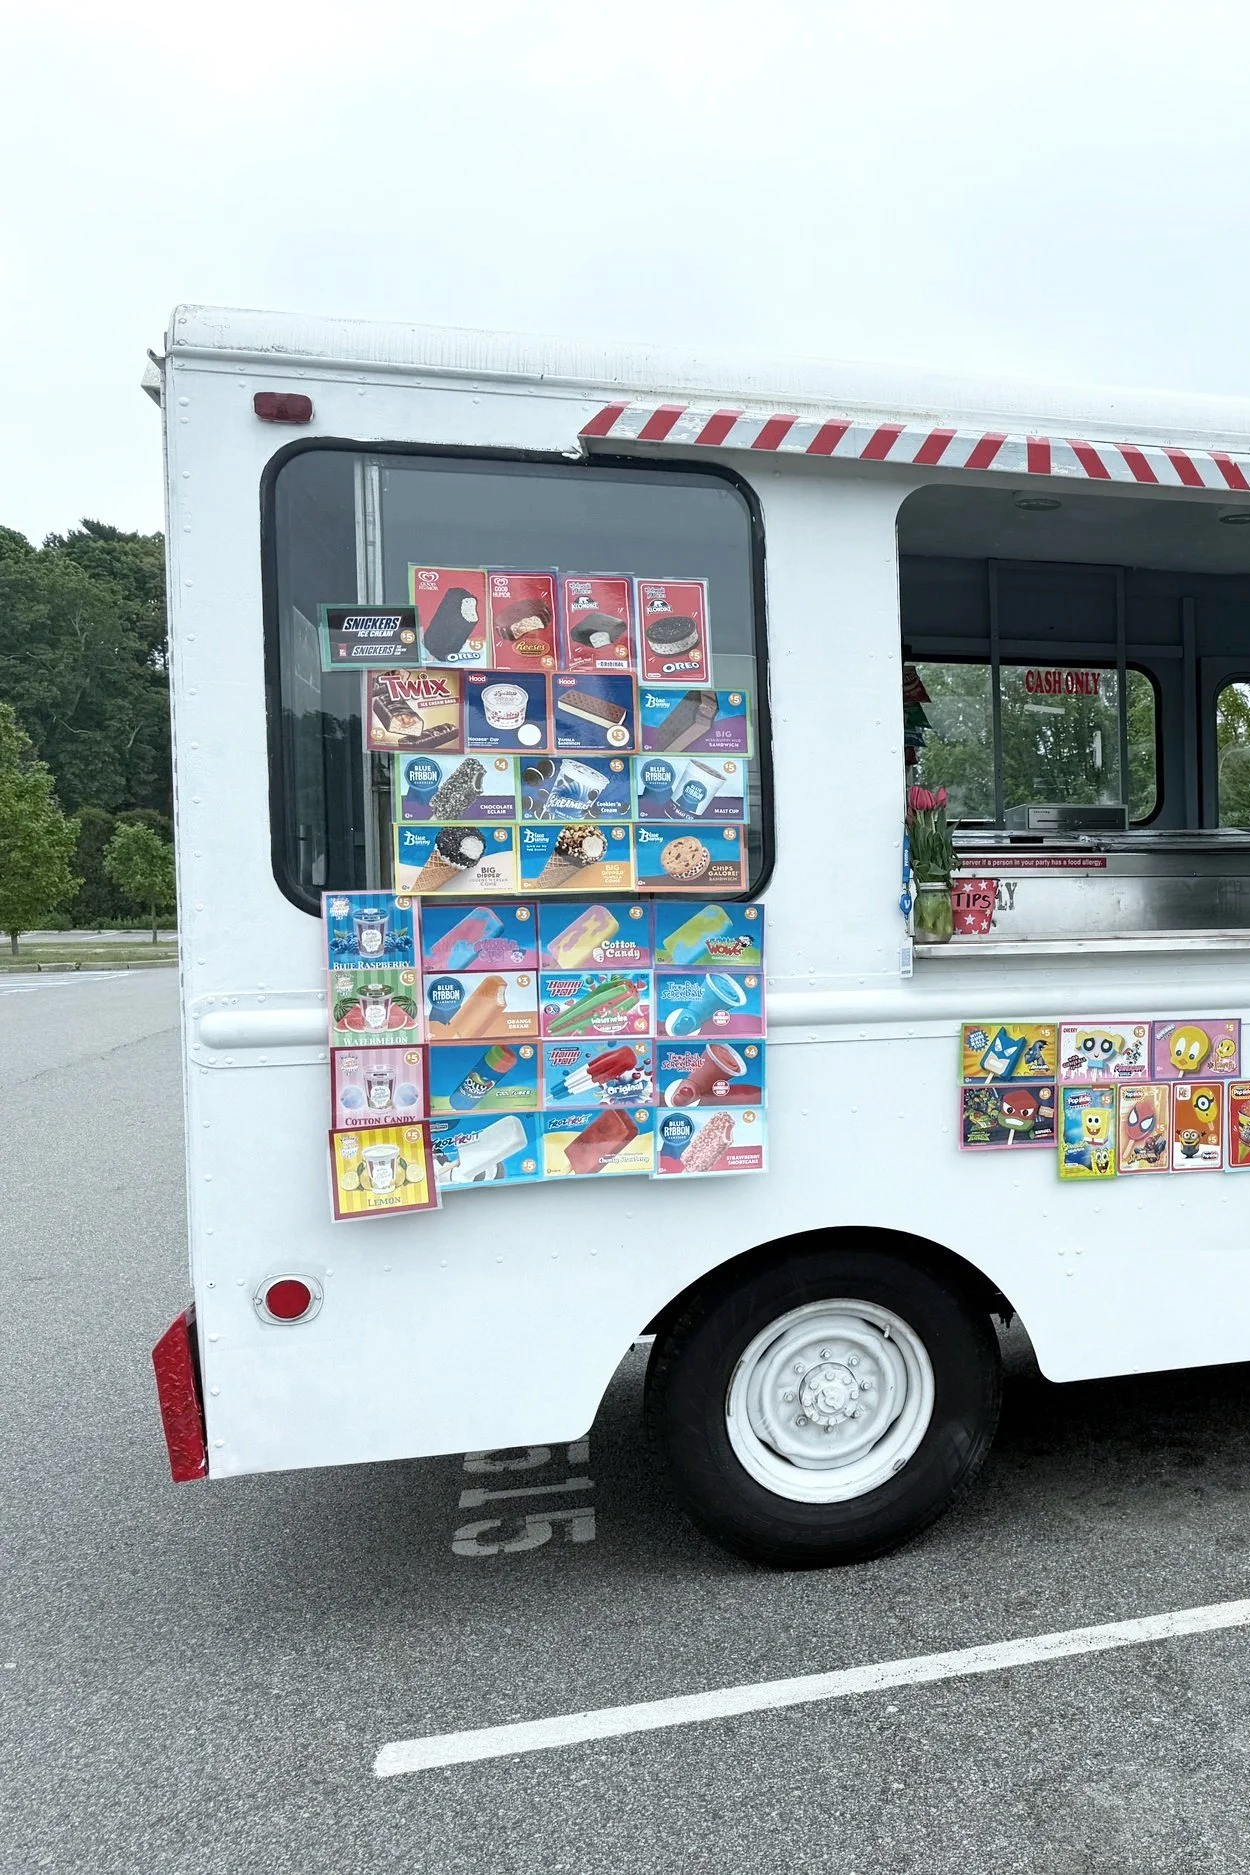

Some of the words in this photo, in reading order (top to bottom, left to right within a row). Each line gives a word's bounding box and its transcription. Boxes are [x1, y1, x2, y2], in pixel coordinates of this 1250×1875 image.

[343, 617, 401, 631] SNICKERS
[352, 645, 395, 656] SNICKERS
[470, 643, 481, 651] $5
[615, 647, 626, 655] $5
[447, 652, 480, 662] OREO
[690, 651, 701, 659] $5
[662, 662, 699, 673] OREO
[1025, 670, 1062, 695] CASH
[1065, 671, 1100, 696] ONLY
[715, 730, 732, 738] BIG
[495, 760, 506, 769] $4
[611, 762, 622, 770] $5
[725, 763, 735, 771] $5
[409, 771, 437, 781] RIBBON
[645, 772, 671, 782] RIBBON
[1082, 859, 1103, 867] allergy.
[399, 898, 410, 906] $5
[952, 892, 992, 909] TIPS
[517, 910, 528, 919] $3
[630, 909, 641, 918] $3
[746, 910, 756, 919] $3
[602, 941, 636, 950] Cotton
[606, 949, 640, 960] Candy
[333, 962, 355, 970] BLUE
[357, 960, 411, 970] RASPBERRY
[403, 974, 414, 982] $5
[517, 977, 528, 985] $3
[432, 990, 460, 1001] RIBBON
[343, 1036, 408, 1046] WATERMELON
[634, 1044, 645, 1053] $4
[407, 1054, 418, 1062] $5
[345, 1117, 382, 1126] COTTON
[384, 1115, 416, 1125] CANDY
[407, 1131, 418, 1140] $5
[664, 1126, 690, 1137] RIBBON
[368, 1197, 401, 1207] LEMON
